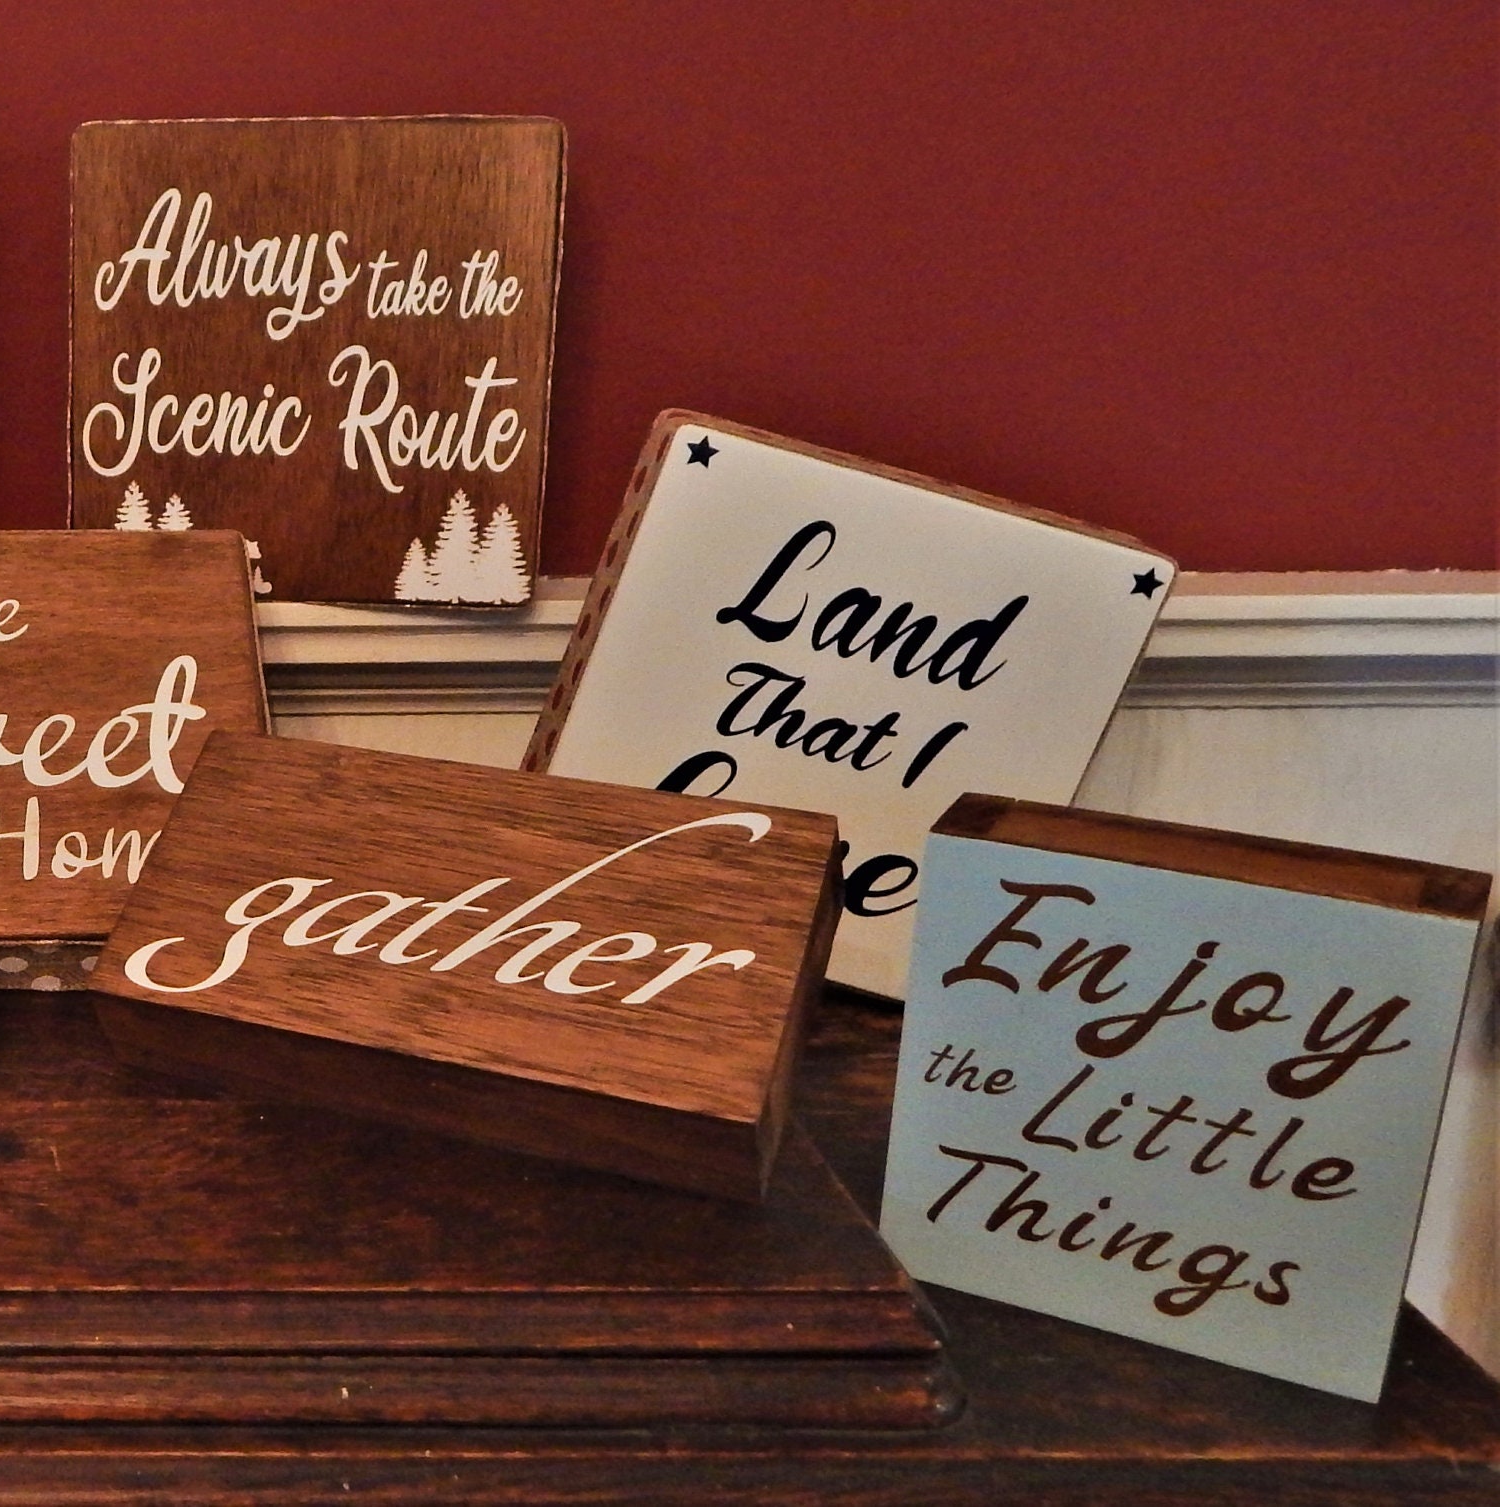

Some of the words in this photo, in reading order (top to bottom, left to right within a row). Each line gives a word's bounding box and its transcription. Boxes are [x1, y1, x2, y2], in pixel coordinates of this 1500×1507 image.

[94, 187, 362, 341] Always
[367, 248, 452, 320] take
[460, 248, 523, 319] the
[82, 347, 311, 478] Scenic
[328, 344, 527, 494] Route
[716, 520, 1030, 691] Land
[715, 661, 903, 771] That
[124, 812, 773, 1005] gather
[942, 878, 1412, 1099] Enjoy
[922, 1044, 1017, 1096] the
[1021, 1064, 1358, 1202] Little
[926, 1144, 1302, 1318] Things
